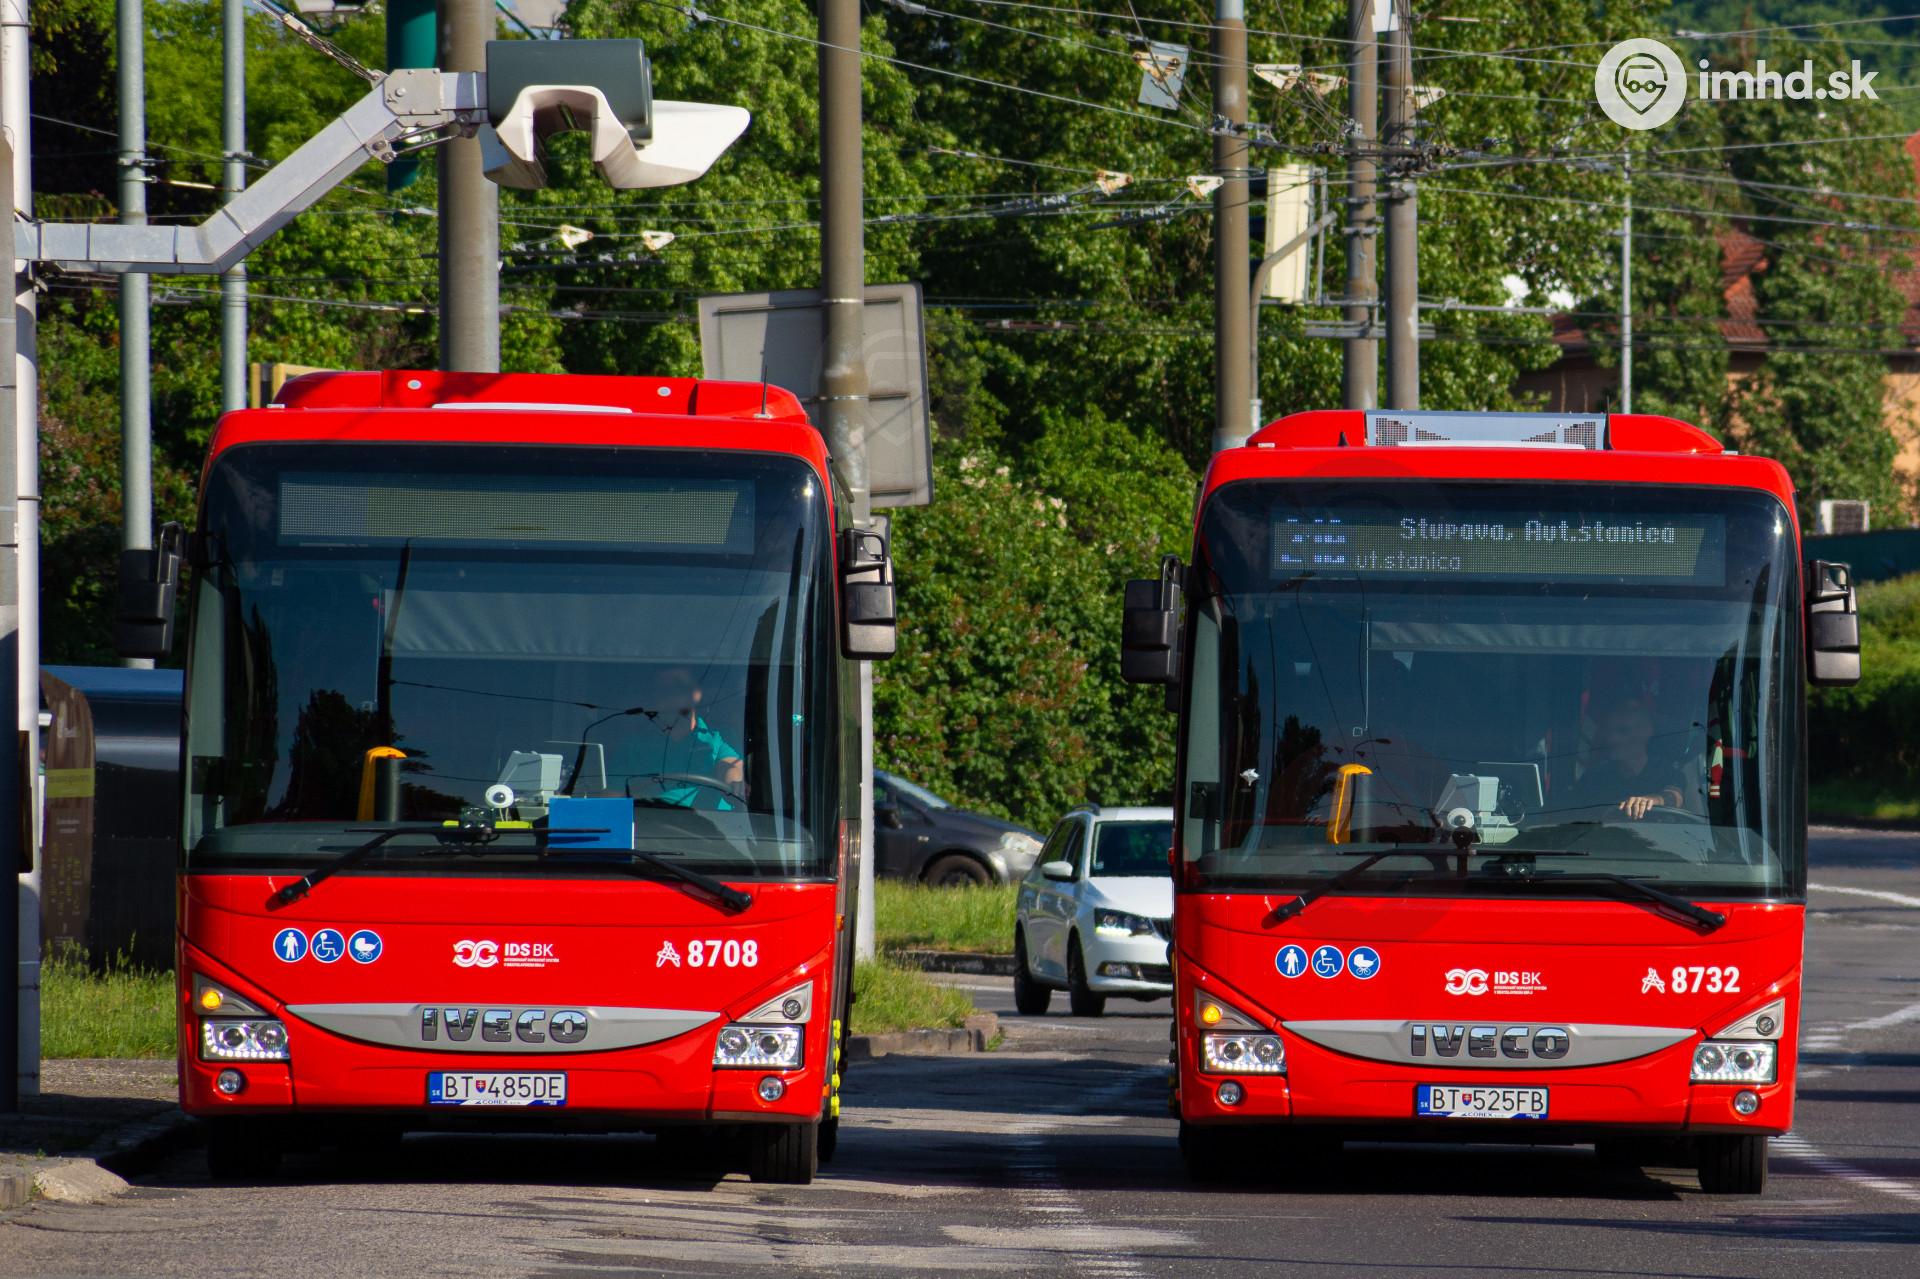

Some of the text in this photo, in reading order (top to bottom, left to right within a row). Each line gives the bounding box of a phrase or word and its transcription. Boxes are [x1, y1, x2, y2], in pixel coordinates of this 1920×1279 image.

[1525, 519, 1676, 543] Aut.stanica
[1356, 550, 1462, 570] ut.stanica
[504, 943, 554, 957] IDS BK
[687, 939, 759, 968] 8708
[1494, 971, 1542, 985] IDS BK
[1671, 966, 1741, 994] 8732
[421, 1008, 588, 1044] IVECO
[1410, 1024, 1570, 1060] IVECO
[445, 1076, 474, 1098] BT
[487, 1076, 562, 1098] 485DE
[1432, 1088, 1460, 1110] BT
[1473, 1090, 1544, 1112] 525FB
